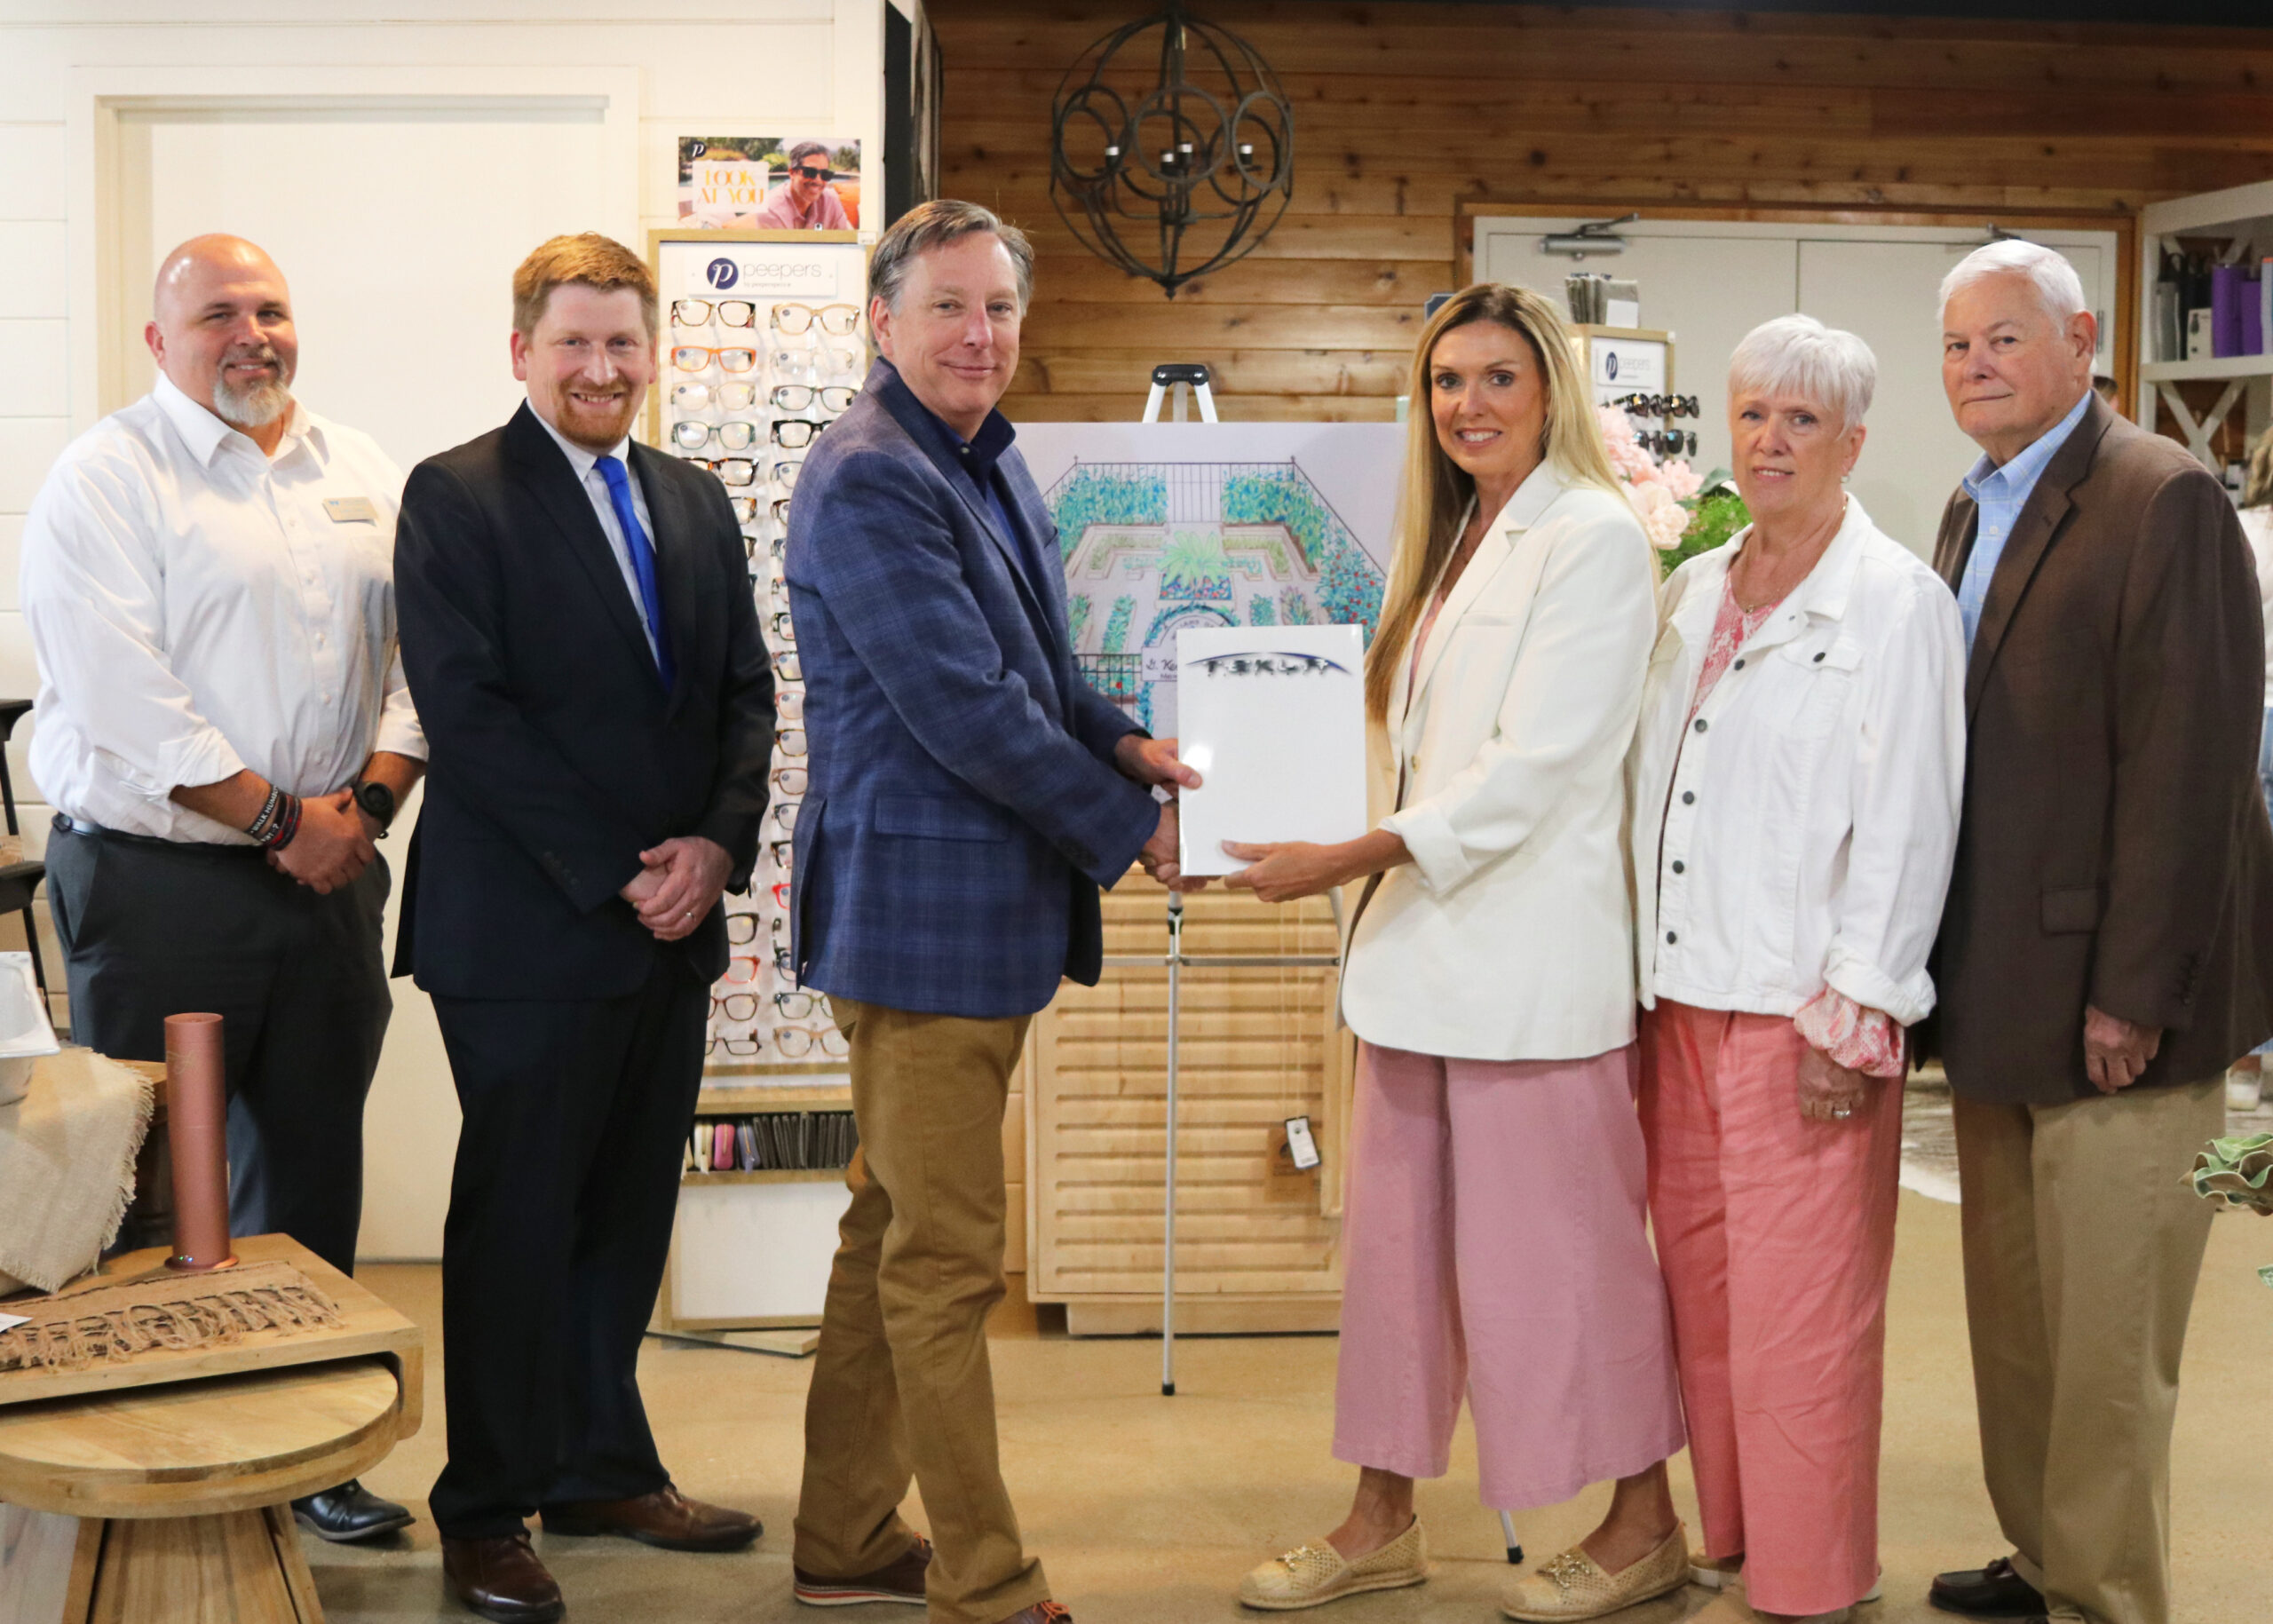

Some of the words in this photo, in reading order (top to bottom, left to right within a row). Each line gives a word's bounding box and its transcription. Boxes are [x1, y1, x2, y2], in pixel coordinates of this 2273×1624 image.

[705, 170, 756, 186] LOOK
[697, 187, 717, 204] AT
[727, 187, 764, 204] YOU
[743, 263, 821, 280] peepers
[251, 813, 268, 831] WALK
